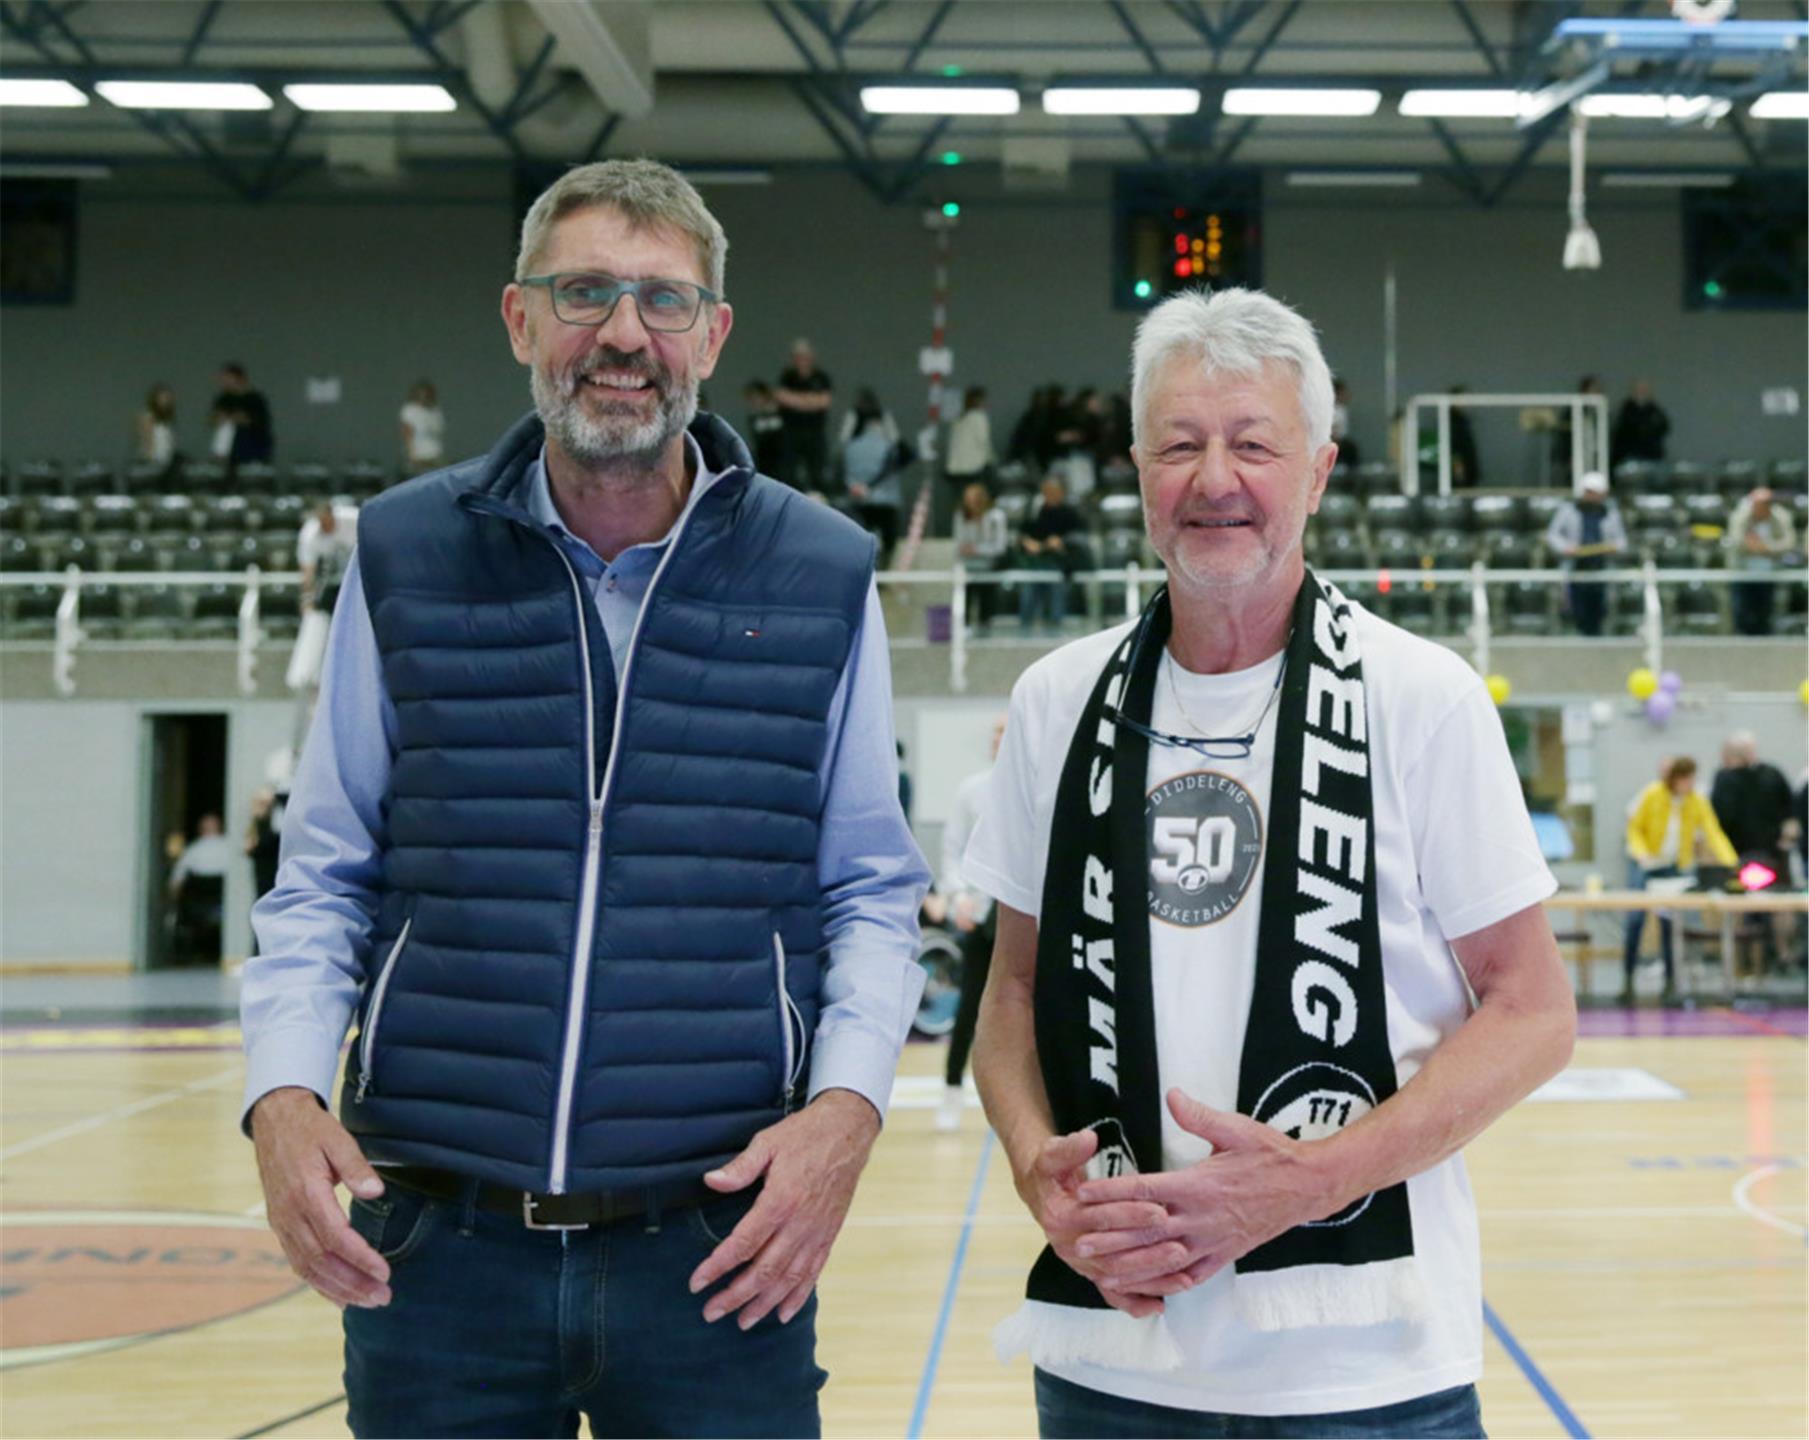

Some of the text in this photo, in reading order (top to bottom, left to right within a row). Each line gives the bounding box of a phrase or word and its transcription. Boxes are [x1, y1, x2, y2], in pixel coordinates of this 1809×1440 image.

[1151, 775, 1248, 805] DIDDELENG
[1151, 816, 1237, 884] 50
[1072, 854, 1120, 1097] MÄR
[1309, 1097, 1352, 1127] T71
